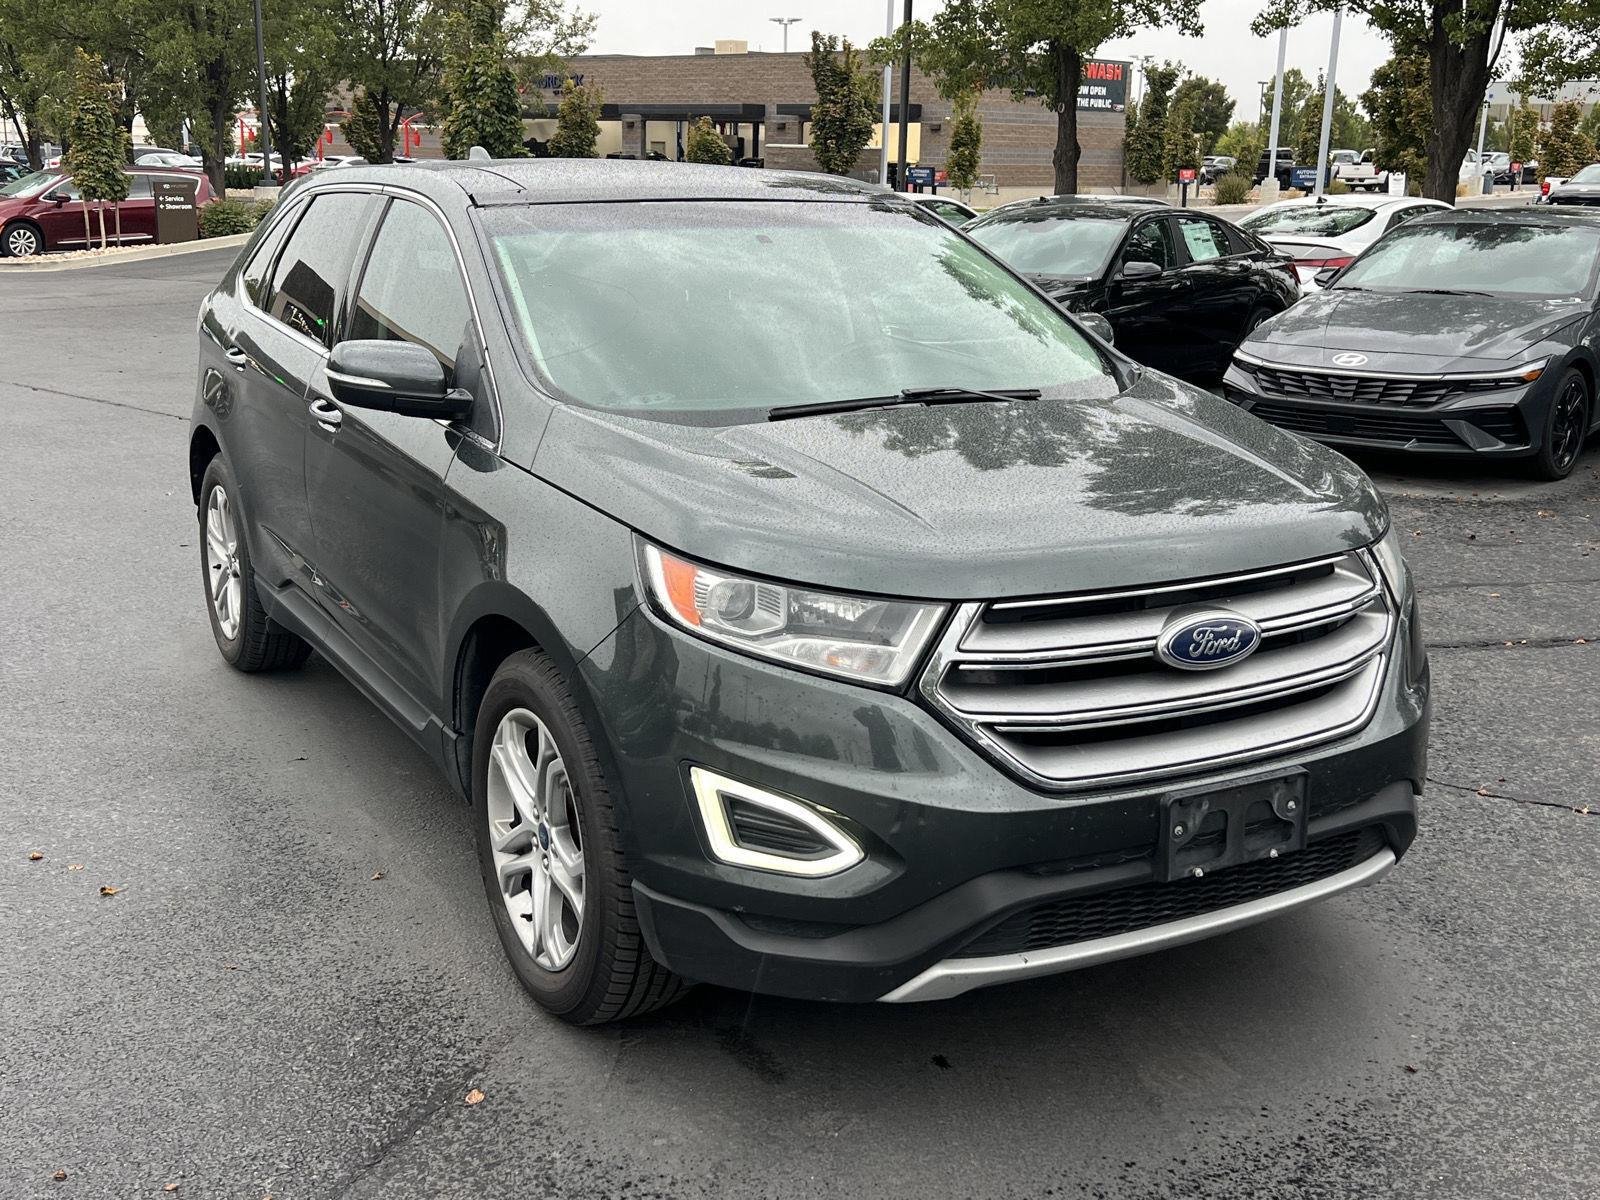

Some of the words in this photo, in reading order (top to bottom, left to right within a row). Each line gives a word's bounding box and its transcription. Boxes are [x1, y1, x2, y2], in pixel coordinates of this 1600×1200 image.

[1087, 62, 1123, 80] WASH
[1089, 86, 1107, 96] OPEN
[1076, 97, 1089, 107] THE
[1089, 98, 1112, 108] PUBLIC
[1189, 625, 1242, 658] Ford
